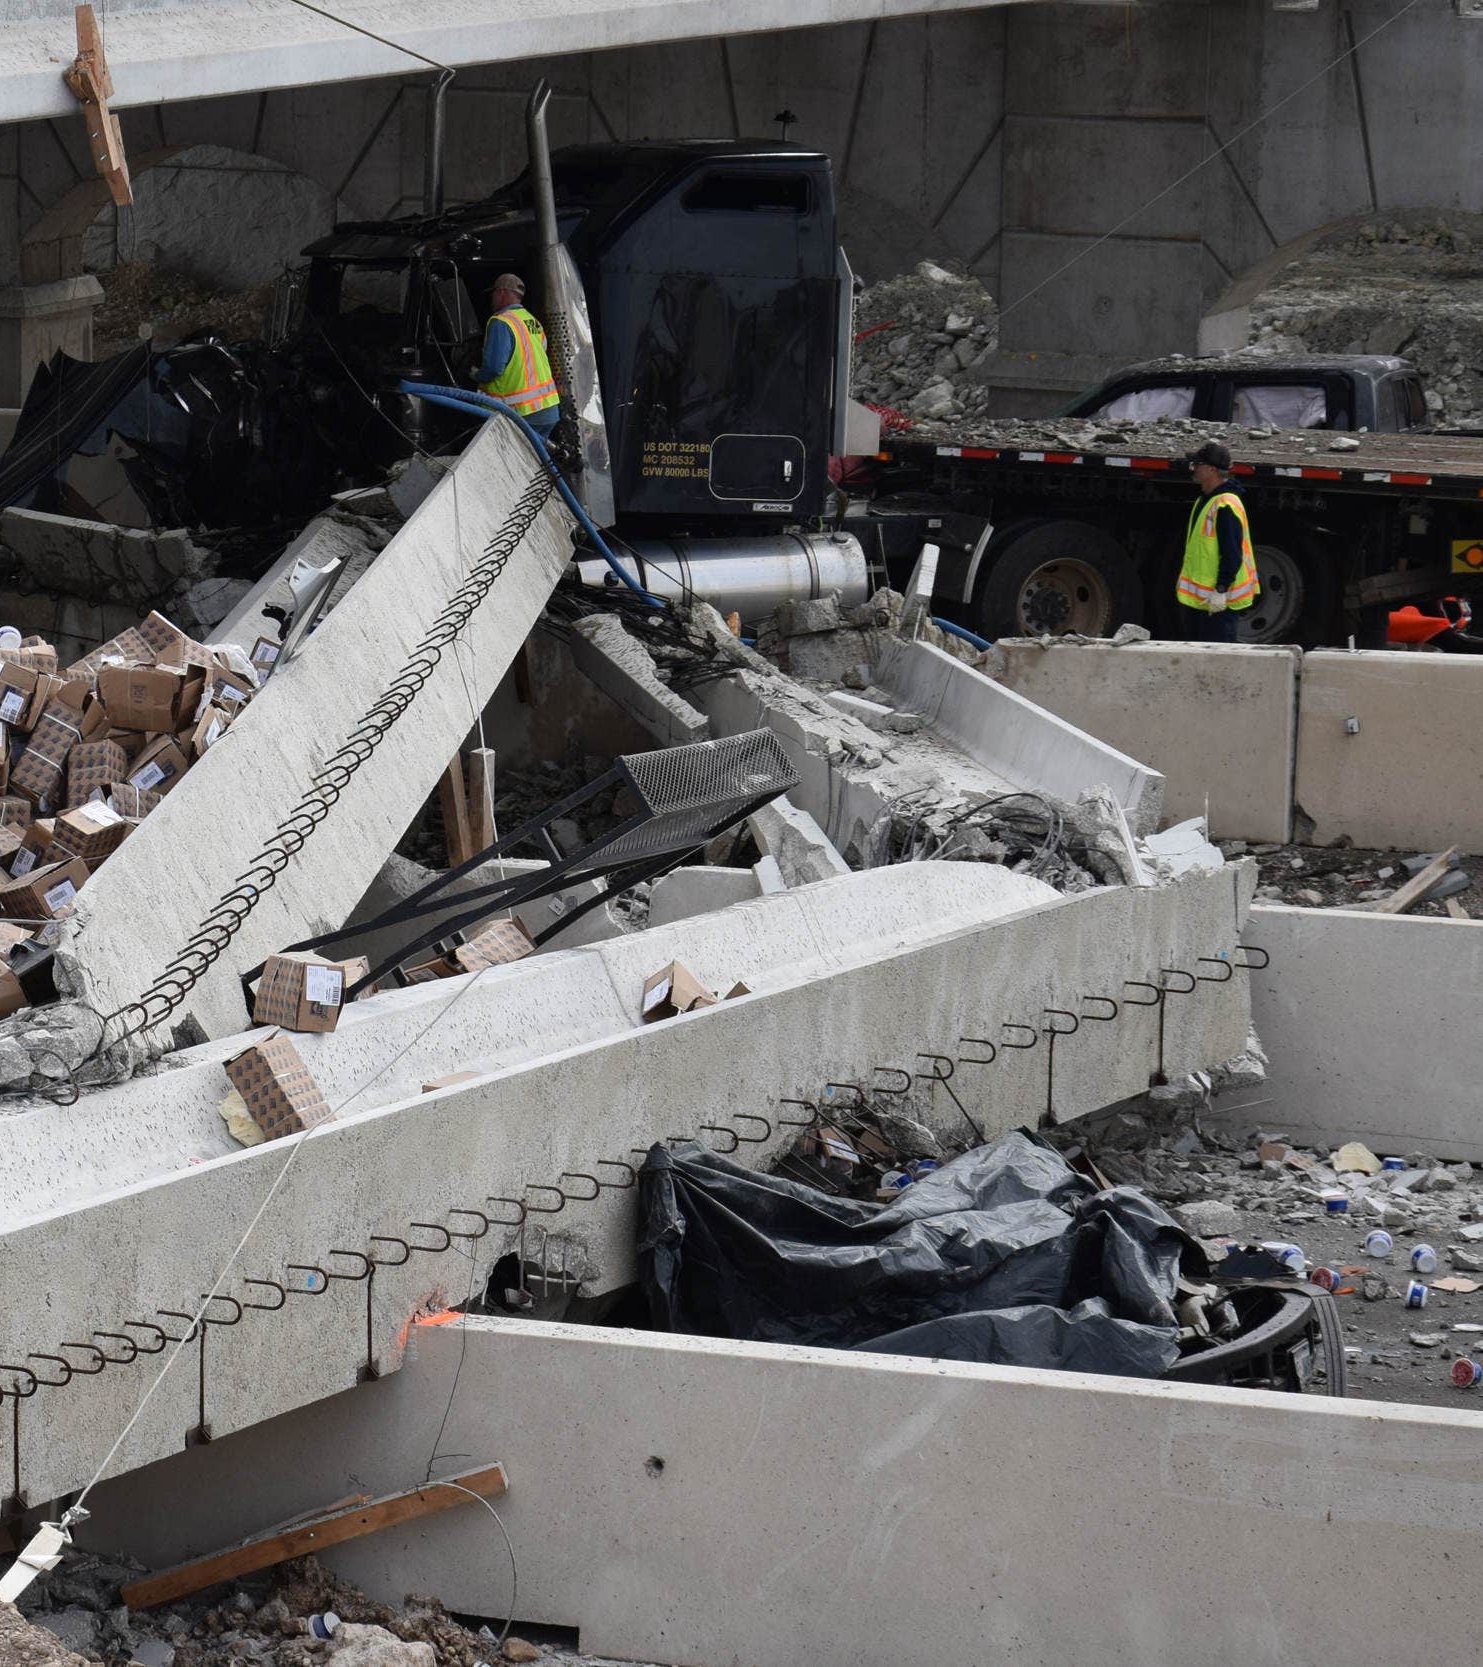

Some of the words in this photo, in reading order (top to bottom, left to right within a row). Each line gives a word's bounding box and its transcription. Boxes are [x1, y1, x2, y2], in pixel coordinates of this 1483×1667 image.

[643, 442, 656, 451] US
[658, 442, 677, 452] DOT
[643, 455, 659, 464] MC
[660, 455, 695, 465] 208532
[642, 467, 664, 477] GVW
[665, 468, 690, 477] 80000
[691, 468, 709, 478] LBS
